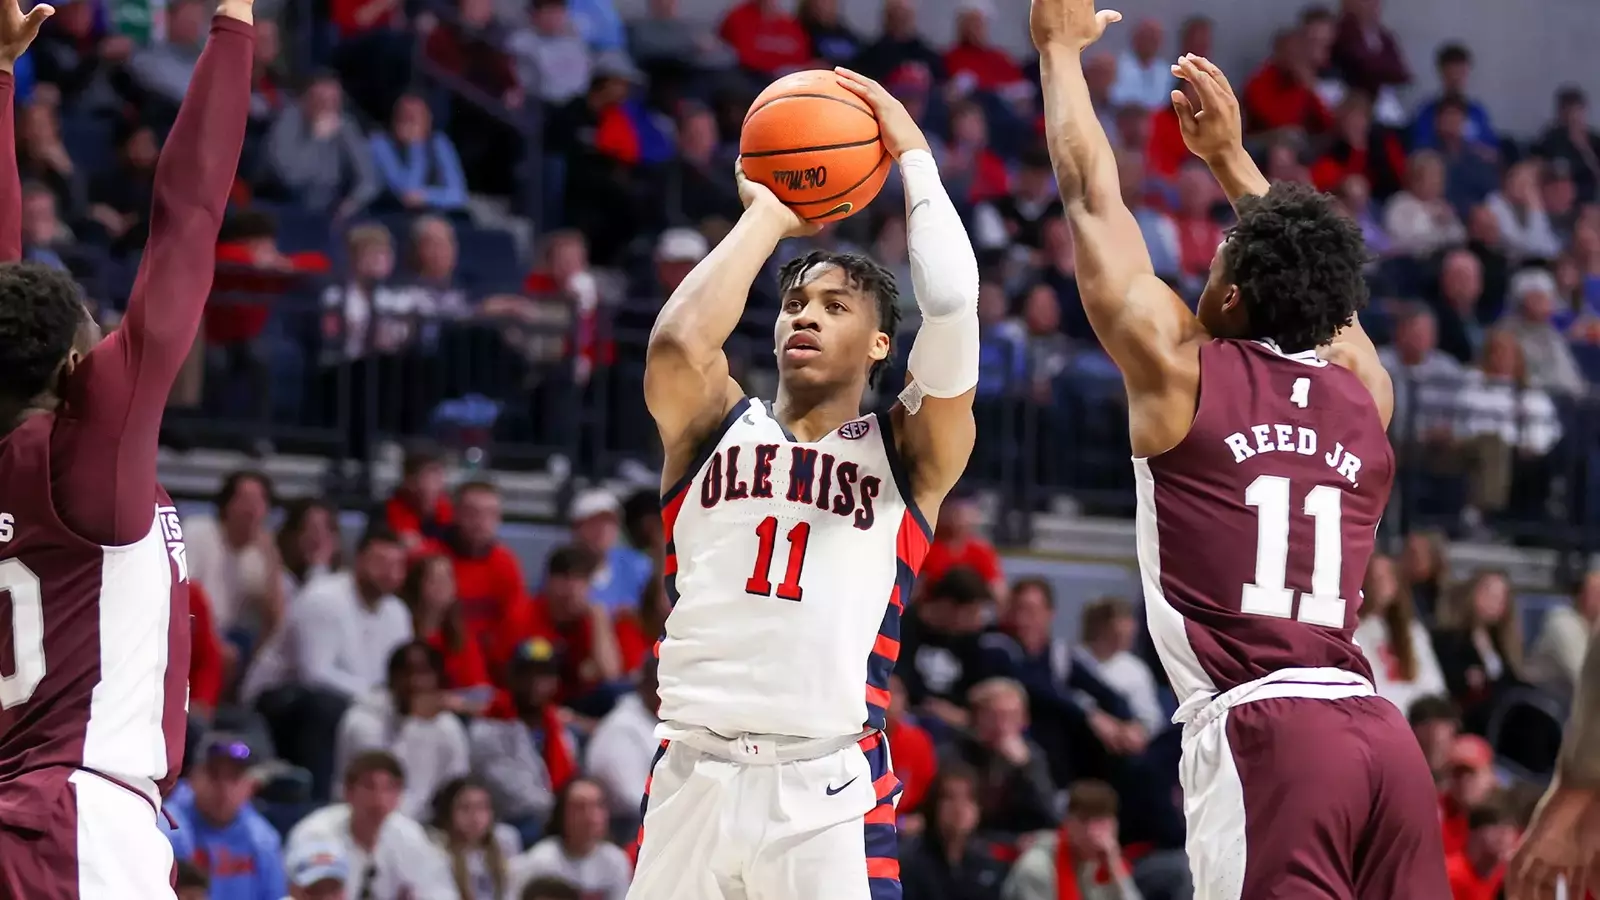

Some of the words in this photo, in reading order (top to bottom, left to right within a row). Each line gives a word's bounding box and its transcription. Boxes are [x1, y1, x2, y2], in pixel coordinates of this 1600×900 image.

[772, 170, 807, 190] Miss
[804, 166, 827, 188] Ole
[841, 421, 869, 439] SEC
[1224, 424, 1317, 463] REED
[700, 444, 780, 509] OLE
[785, 446, 881, 530] MISS
[745, 516, 810, 601] 11
[1241, 475, 1346, 628] 11
